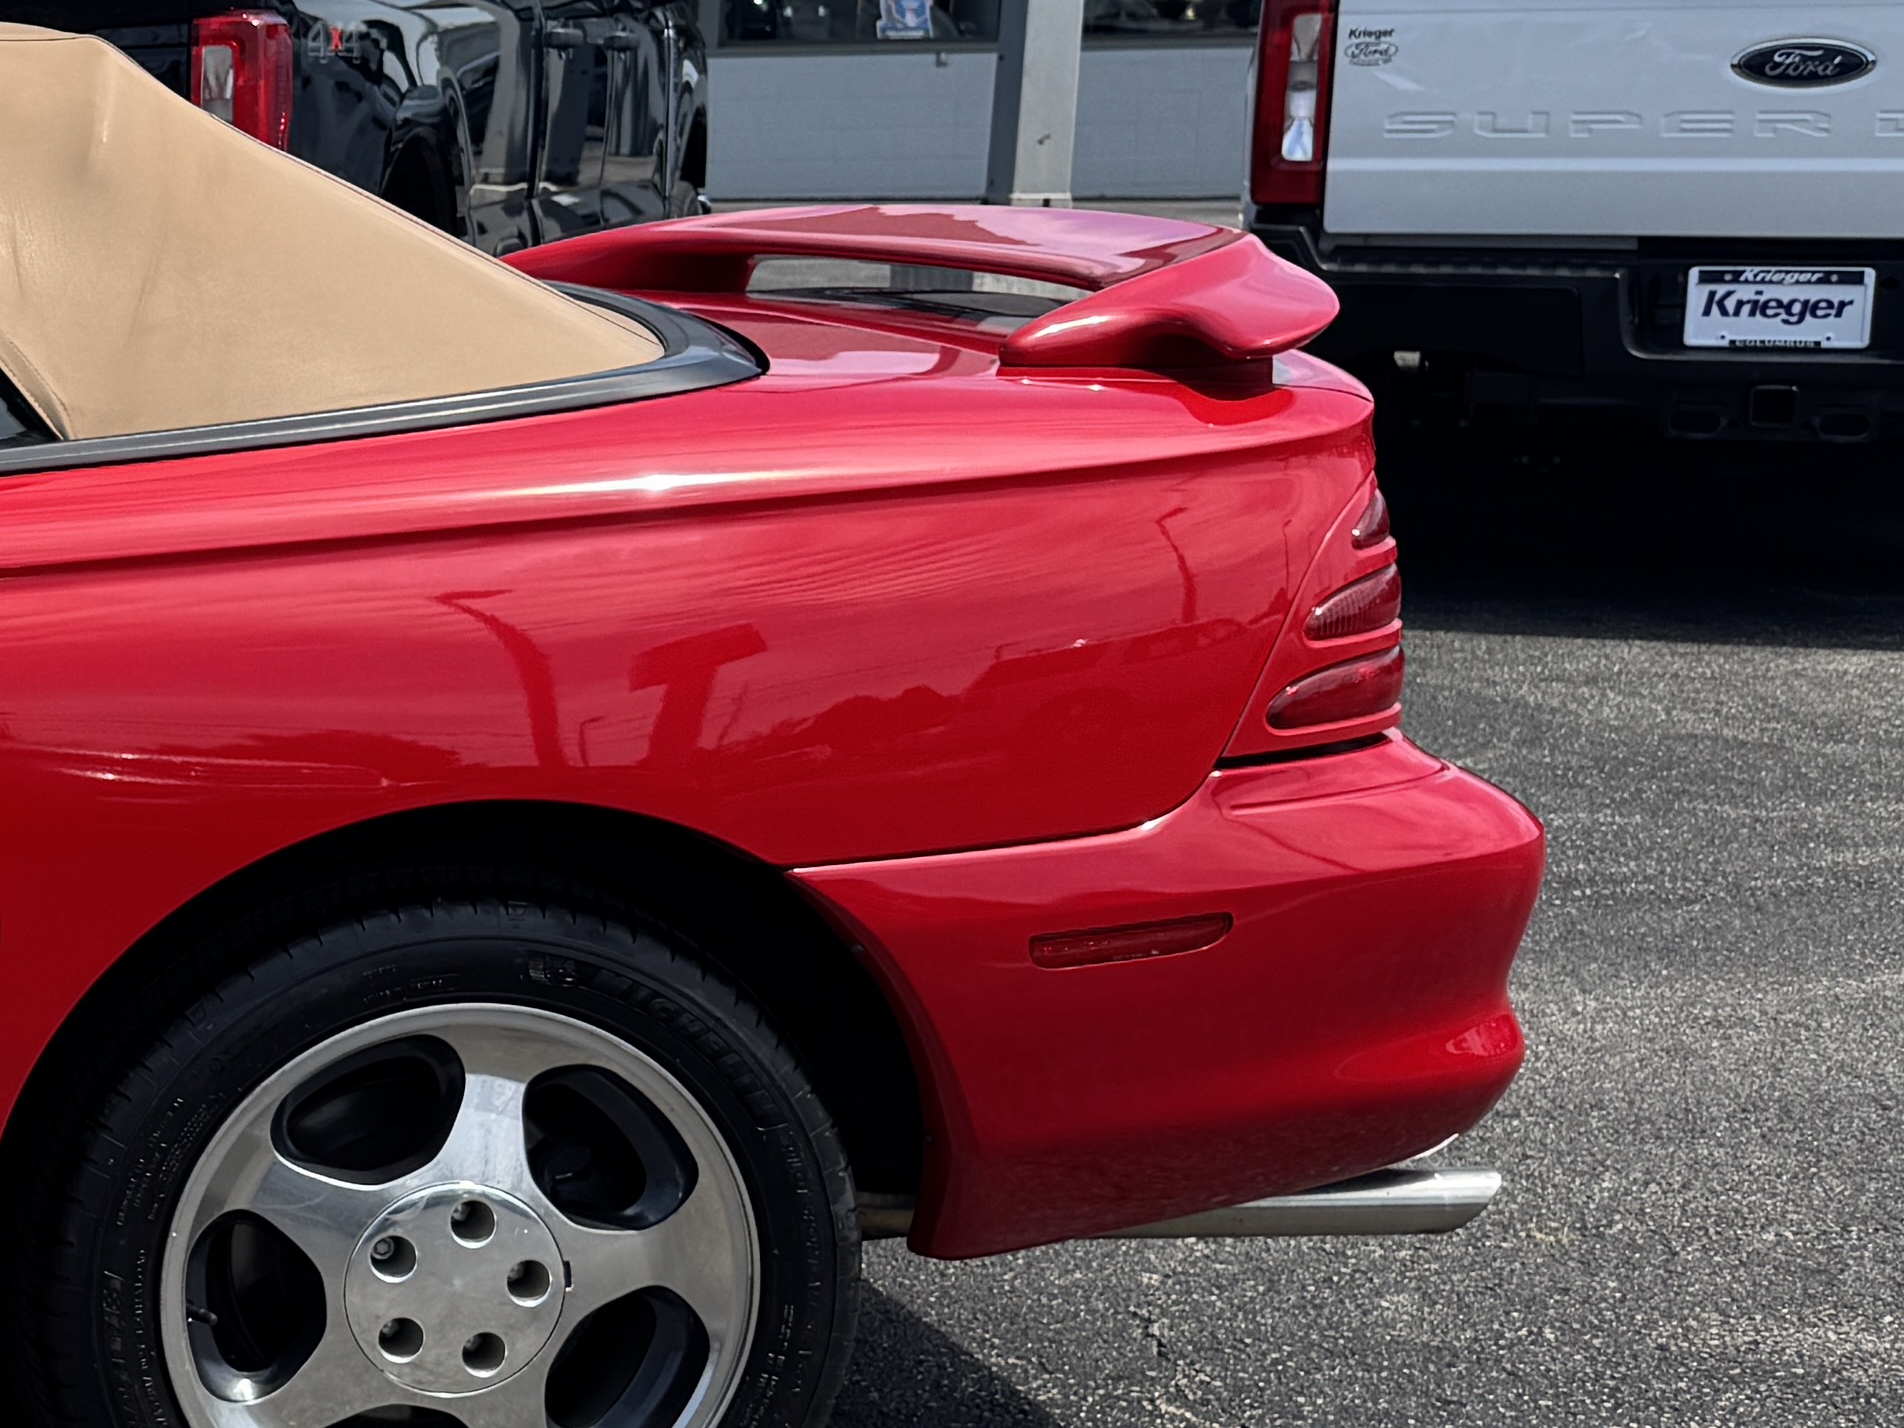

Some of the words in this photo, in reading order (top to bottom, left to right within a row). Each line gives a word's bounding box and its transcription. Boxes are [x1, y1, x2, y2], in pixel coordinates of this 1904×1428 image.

[1764, 49, 1843, 76] Ford
[1383, 110, 1832, 139] SUPER
[1739, 269, 1824, 285] Krieger
[1701, 289, 1855, 326] Krieger
